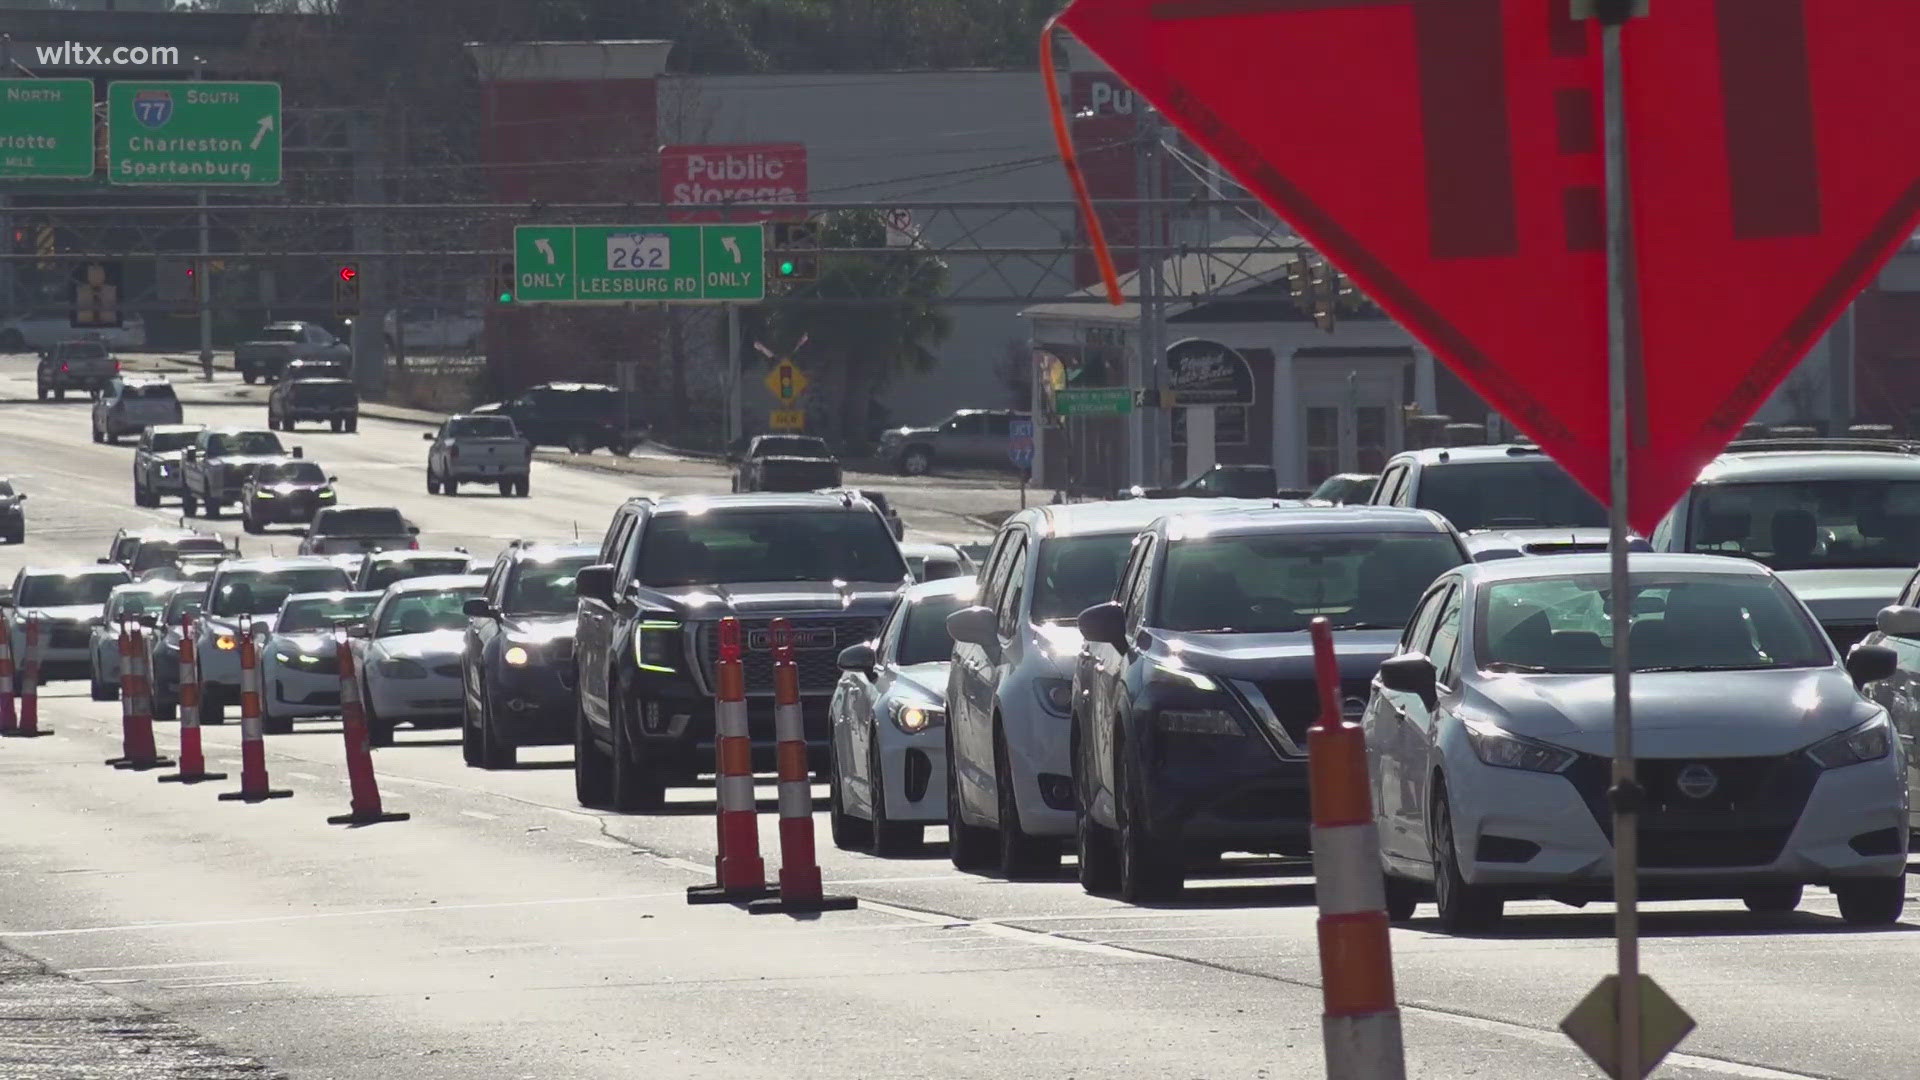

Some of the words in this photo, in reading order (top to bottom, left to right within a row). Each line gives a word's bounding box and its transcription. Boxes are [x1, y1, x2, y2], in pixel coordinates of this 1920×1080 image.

[139, 102, 166, 121] 77
[129, 136, 242, 152] Charleston
[121, 160, 252, 181] Spartanburg
[687, 152, 785, 181] Public
[673, 182, 798, 209] Storage
[612, 247, 663, 270] 262
[522, 272, 566, 289] ONLY
[580, 276, 668, 293] LEESBURG
[674, 276, 697, 292] RD
[707, 271, 752, 287] ONLY
